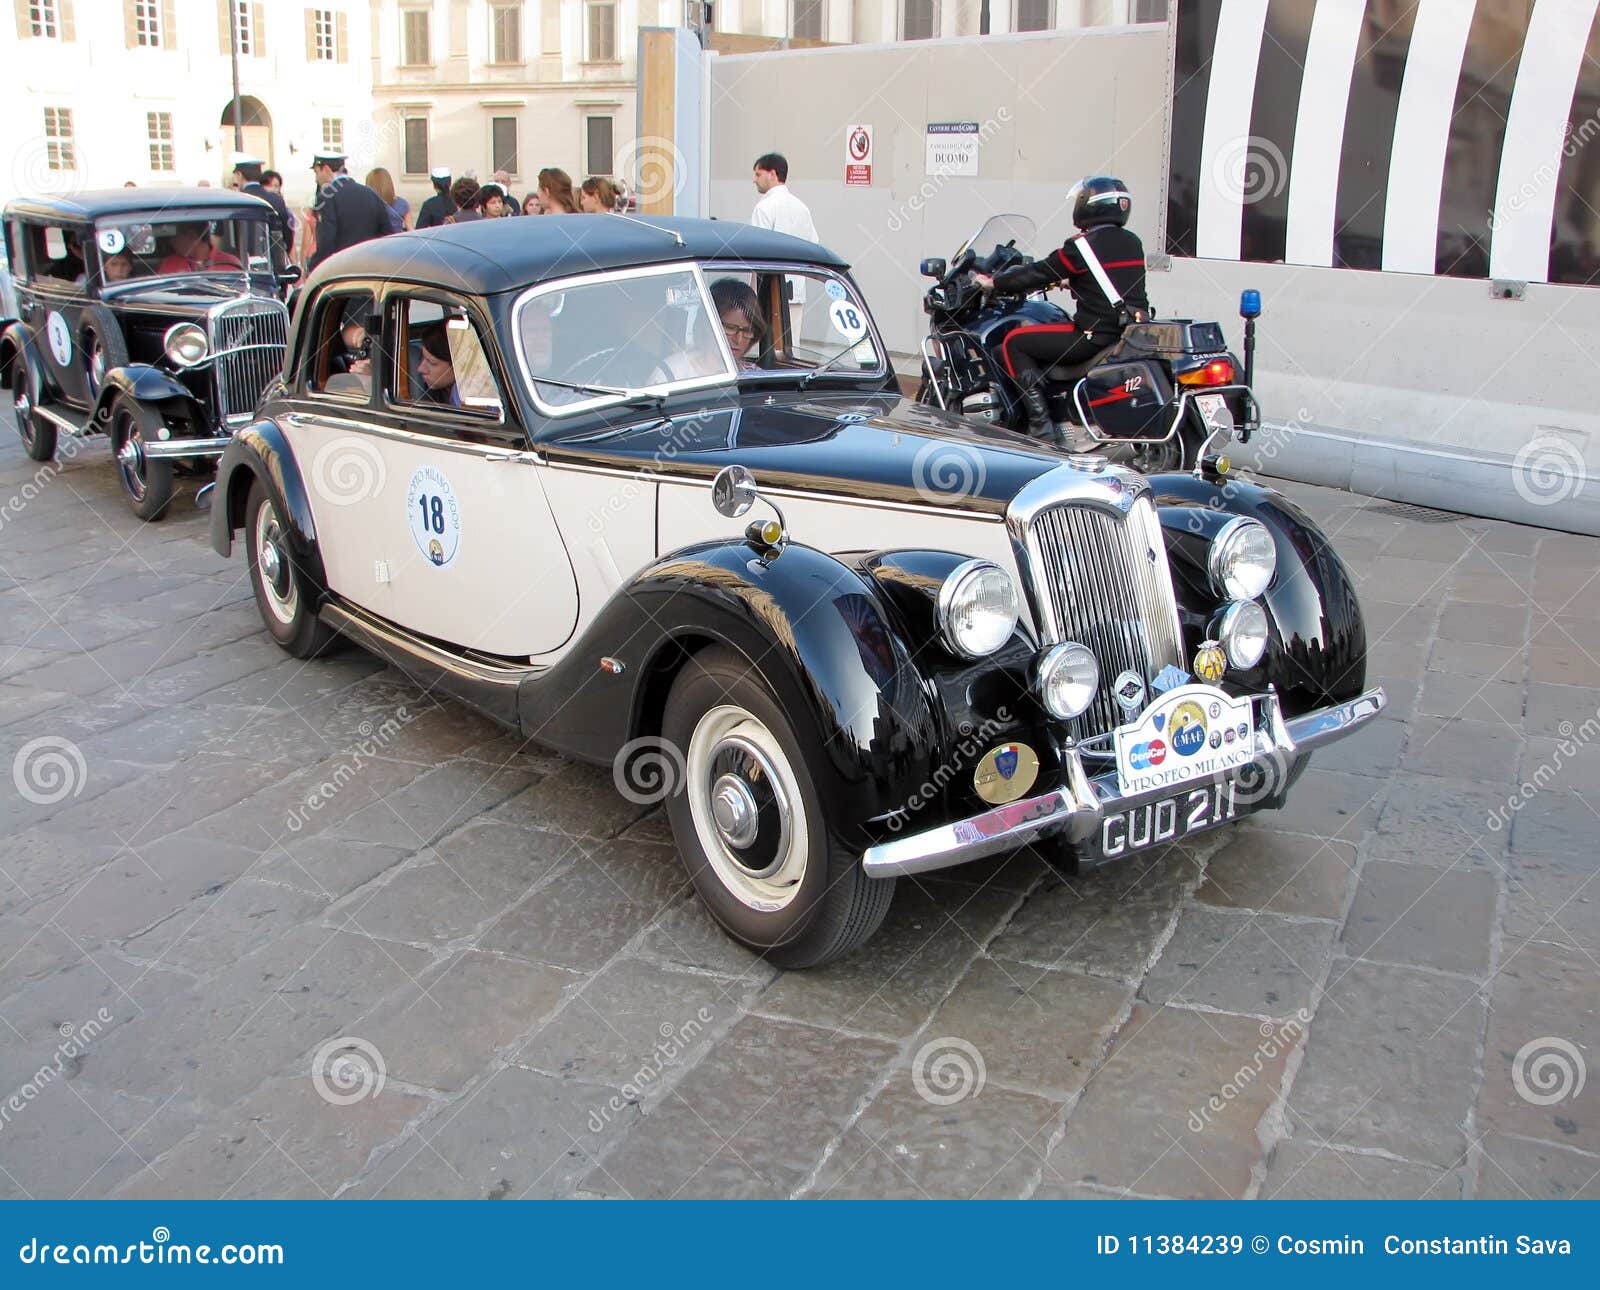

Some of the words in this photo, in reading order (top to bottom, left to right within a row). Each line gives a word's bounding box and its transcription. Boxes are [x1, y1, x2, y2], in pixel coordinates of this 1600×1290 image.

[935, 153, 968, 163] DUOMO
[107, 233, 115, 247] 3
[835, 308, 861, 329] 18
[56, 333, 63, 346] 3
[1124, 376, 1142, 393] 112
[419, 493, 445, 535] 18
[1131, 766, 1191, 792] TROFEO
[1194, 750, 1248, 776] MILANO
[1102, 798, 1177, 857] GUD
[1187, 780, 1235, 832] 211
